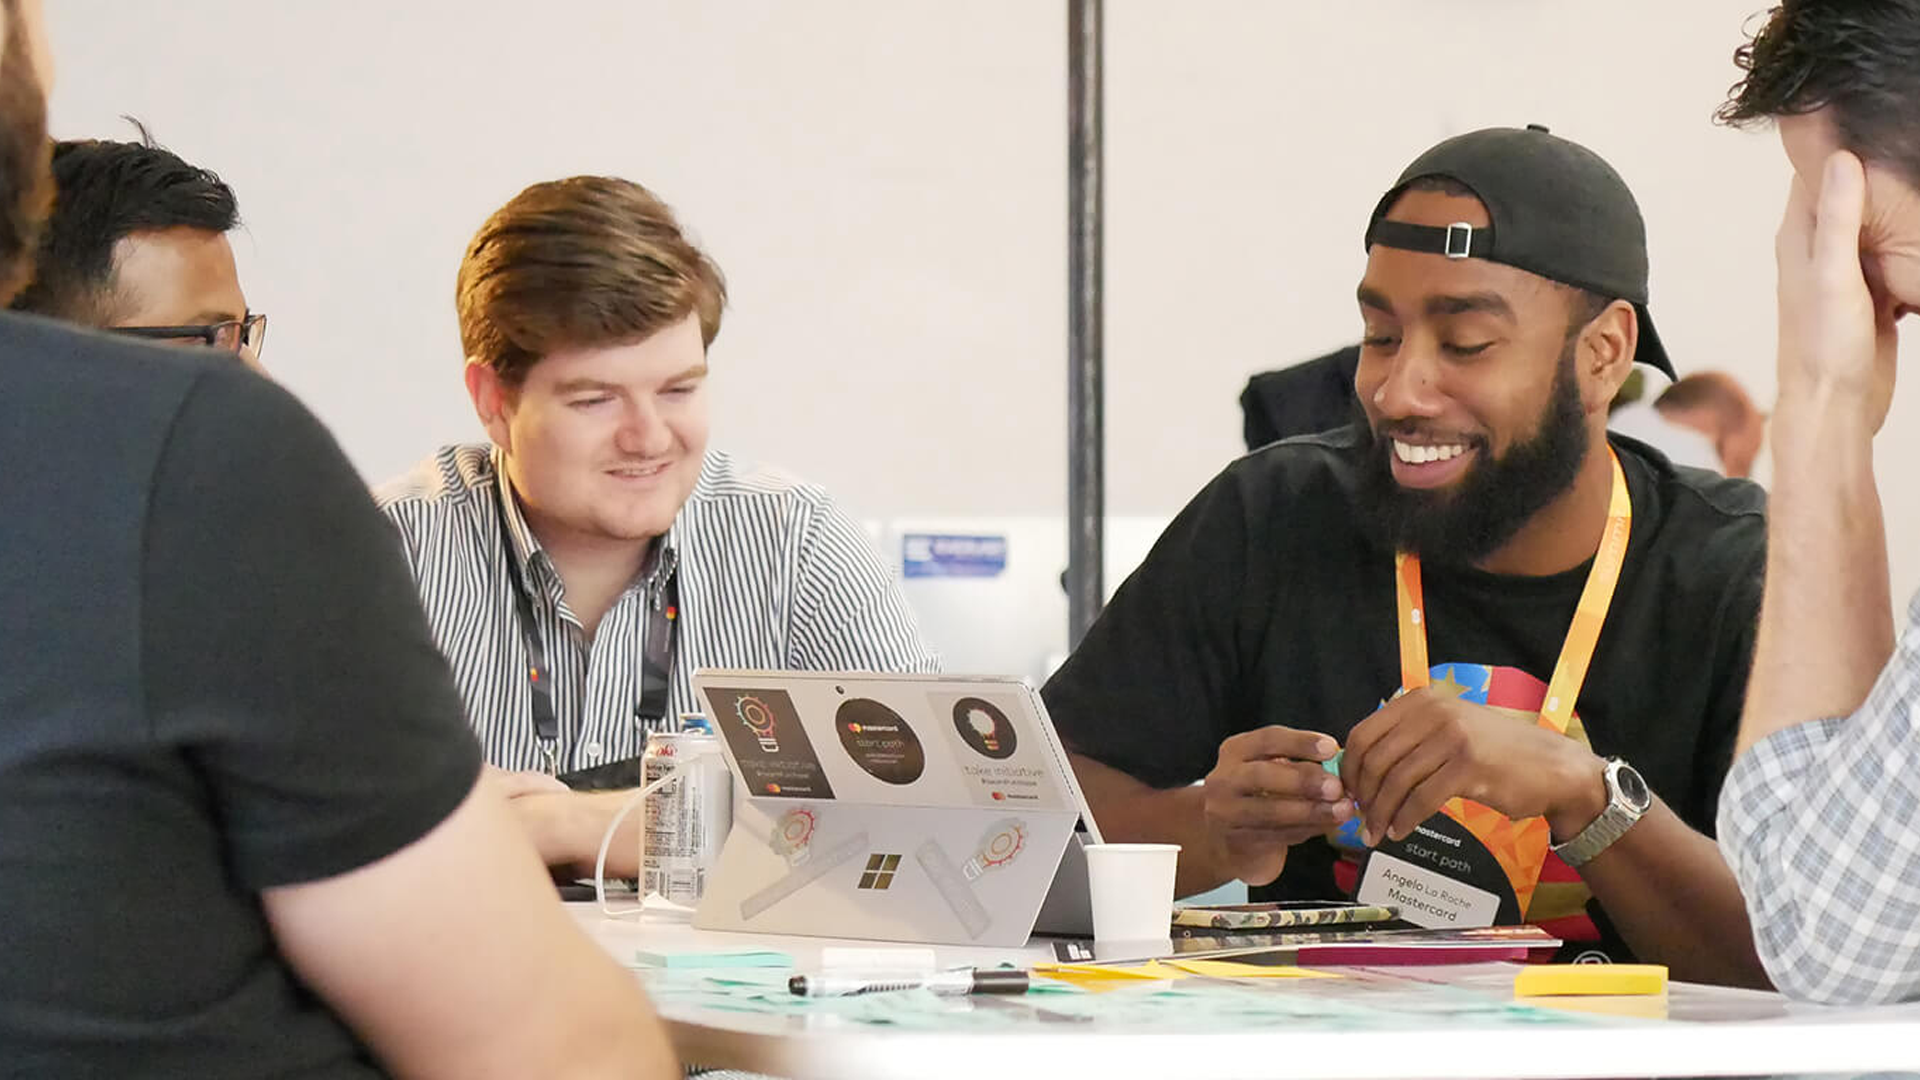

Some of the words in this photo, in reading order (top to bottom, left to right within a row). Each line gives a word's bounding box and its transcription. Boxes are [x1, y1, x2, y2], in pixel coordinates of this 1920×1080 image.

[1404, 843, 1438, 862] start
[1439, 856, 1471, 874] path
[1382, 868, 1423, 891] Angelo
[1425, 885, 1438, 898] La
[1440, 890, 1472, 909] Roche
[1387, 888, 1457, 921] Mastercard
